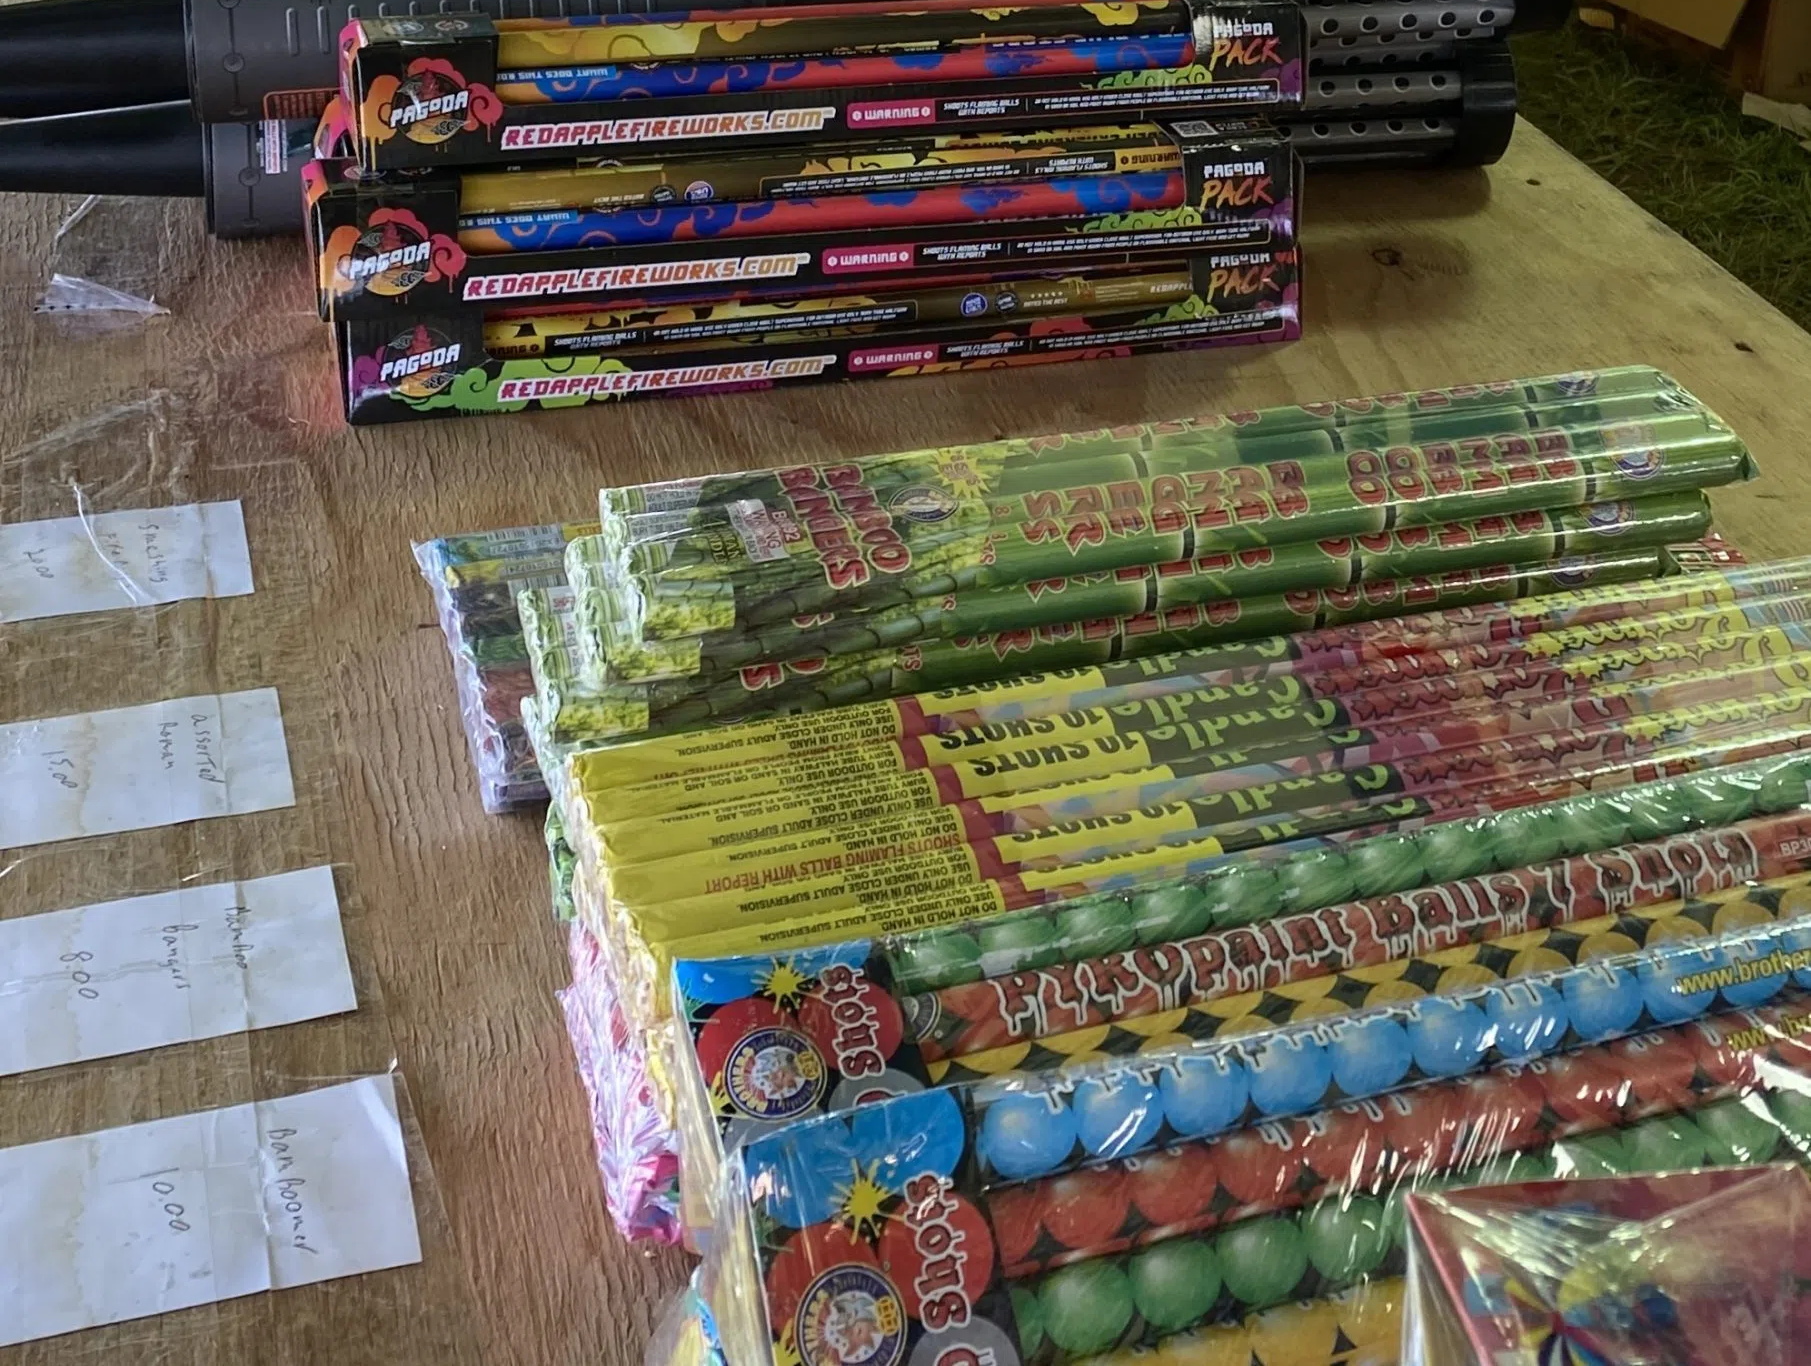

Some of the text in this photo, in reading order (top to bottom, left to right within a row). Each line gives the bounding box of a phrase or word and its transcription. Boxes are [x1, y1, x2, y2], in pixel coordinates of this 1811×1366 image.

[1213, 21, 1274, 38] PAGODA
[1210, 38, 1284, 73] PACK
[389, 89, 469, 128] PAGODA
[864, 107, 920, 121] WARNING
[502, 109, 823, 148] REDAPPLEFIREWORKS.COM
[1203, 161, 1265, 179] PAGODA
[1200, 177, 1275, 214] PACK
[348, 241, 431, 280] PAGODA
[840, 252, 898, 266] WARNING
[465, 255, 799, 299] REDAPPLEFIREWORKS.COM
[1207, 265, 1281, 304] PACK
[379, 343, 462, 382] PAGODA
[865, 350, 923, 365] WARNING
[500, 356, 825, 400] REDAPPLEFIREWORKS.COM
[824, 464, 912, 574] BAMBOO
[776, 465, 870, 590] BANGERS
[885, 800, 911, 813] ONLY
[912, 795, 933, 808] USE
[814, 811, 848, 826] CLOSE
[849, 804, 884, 819] UNDER
[781, 817, 813, 833] ADULT
[843, 843, 904, 866] FLAMING
[798, 854, 842, 874] BALLS
[949, 861, 970, 873] USE
[761, 864, 796, 882] WITH
[883, 871, 919, 885] UNDER
[921, 865, 948, 879] ONLY
[957, 872, 973, 885] DO
[701, 870, 760, 894] REPORT
[847, 878, 881, 892] CLOSE
[903, 881, 932, 894] HOLD
[934, 876, 955, 889] NOT
[811, 884, 845, 900] ADULT
[890, 886, 901, 897] IN
[973, 890, 993, 902] USE
[1360, 868, 1531, 962] Balls
[1588, 826, 1758, 910] Shots
[906, 900, 942, 914] UNDER
[944, 894, 971, 907] ONLY
[981, 900, 997, 912] DO
[870, 908, 904, 921] CLOSE
[926, 909, 956, 922] HOLD
[957, 903, 979, 917] NOT
[833, 914, 867, 928] ADULT
[912, 915, 925, 925] IN
[1677, 948, 1811, 996] www.brother
[821, 963, 885, 1079] Shots
[903, 1171, 971, 1334] Shots
